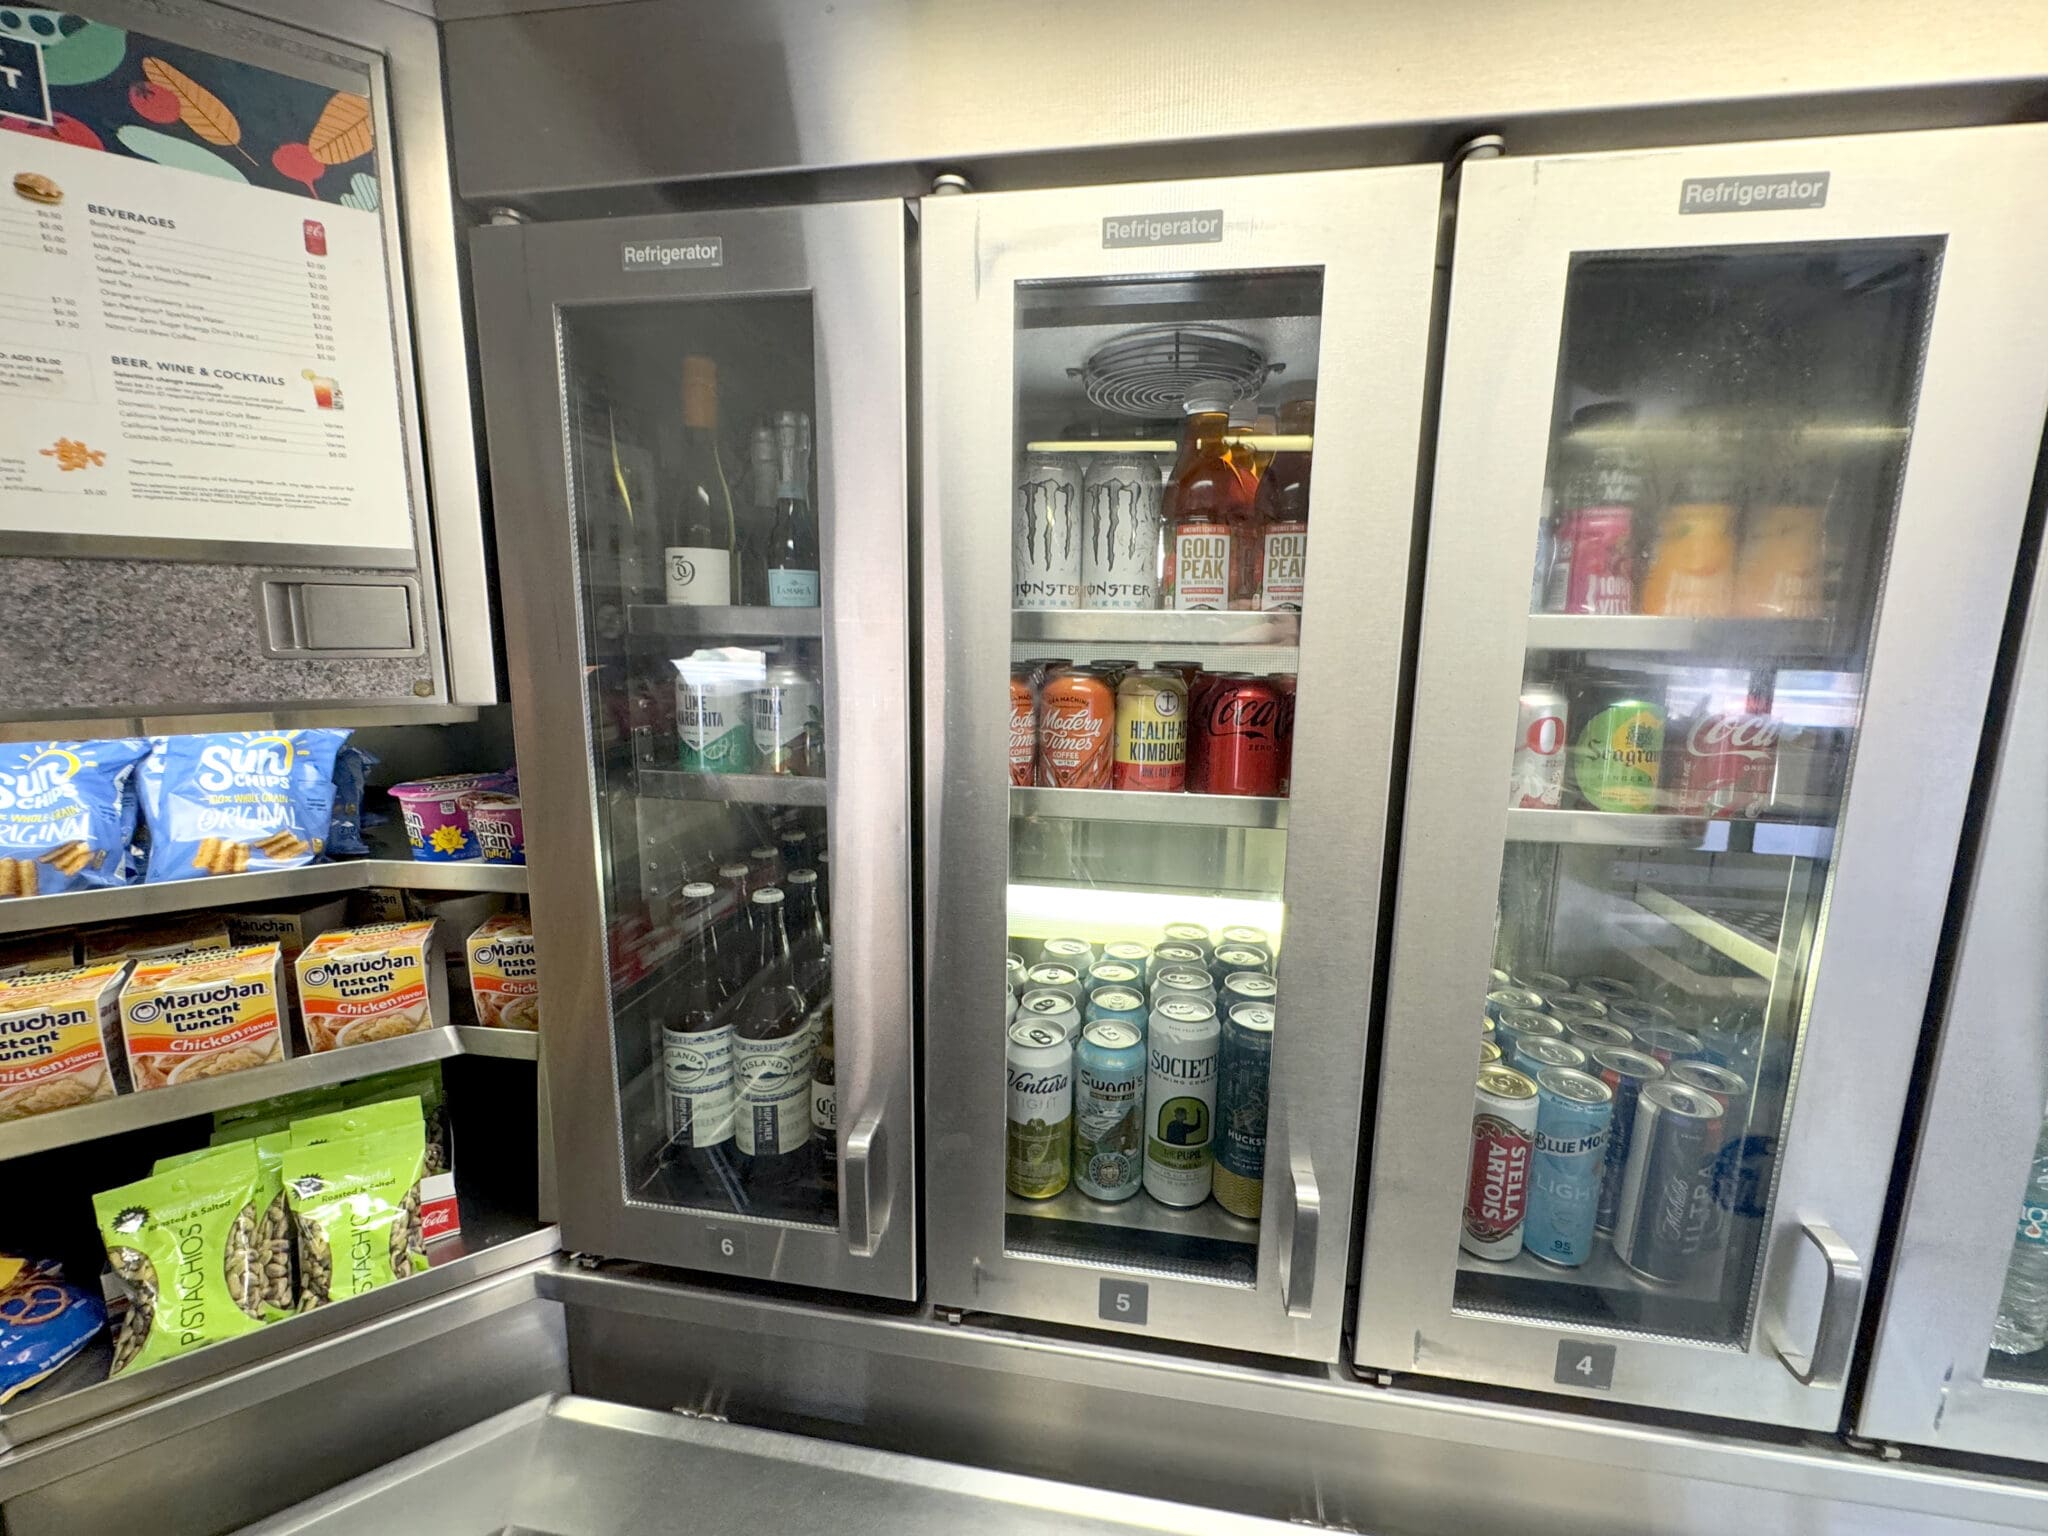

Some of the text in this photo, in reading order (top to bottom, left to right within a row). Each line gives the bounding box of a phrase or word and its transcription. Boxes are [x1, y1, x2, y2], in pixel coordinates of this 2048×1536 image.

[1685, 179, 1822, 206] Refrigerator
[87, 203, 176, 229] BEVERAGES
[1106, 217, 1218, 241] Refrigerator
[624, 244, 717, 265] Refrigerator
[110, 355, 285, 385] BEER, WINE & COCKTAILS
[1182, 538, 1225, 559] GOLD
[1181, 560, 1224, 579] PEAK
[1091, 600, 1144, 608] NERGY
[685, 695, 706, 710] LIME
[1209, 688, 1278, 736] Coca
[1041, 709, 1103, 737] Modern
[1042, 729, 1092, 750] Times
[1687, 713, 1781, 758] Coca
[199, 737, 294, 792] Sun
[1053, 751, 1079, 759] COFFEE
[233, 773, 290, 790] CHIPS
[16, 783, 78, 809] CHIPS
[324, 955, 414, 976] Maruchan
[333, 972, 395, 988] Instant
[341, 983, 389, 997] Lunch
[155, 982, 264, 1010] Maruchan
[336, 990, 423, 1014] Chicken Flavor
[166, 1002, 240, 1023] Instant
[175, 1015, 234, 1033] Lunch
[170, 1020, 274, 1051] Chicken Flavor
[64, 1050, 100, 1065] Flavor
[746, 1059, 783, 1069] ISLAND
[1007, 1068, 1068, 1094] Ventura
[1535, 1131, 1575, 1153] BLUE
[1482, 1141, 1507, 1221] ARTOIS
[1503, 1147, 1526, 1220] STELLA
[191, 1211, 198, 1219] &
[201, 1199, 231, 1215] Salted
[721, 1239, 734, 1255] 6
[1554, 1240, 1571, 1250] 95
[180, 1223, 205, 1346] PISTACHIOS
[1116, 1294, 1131, 1312] 5
[1575, 1355, 1594, 1377] 4
